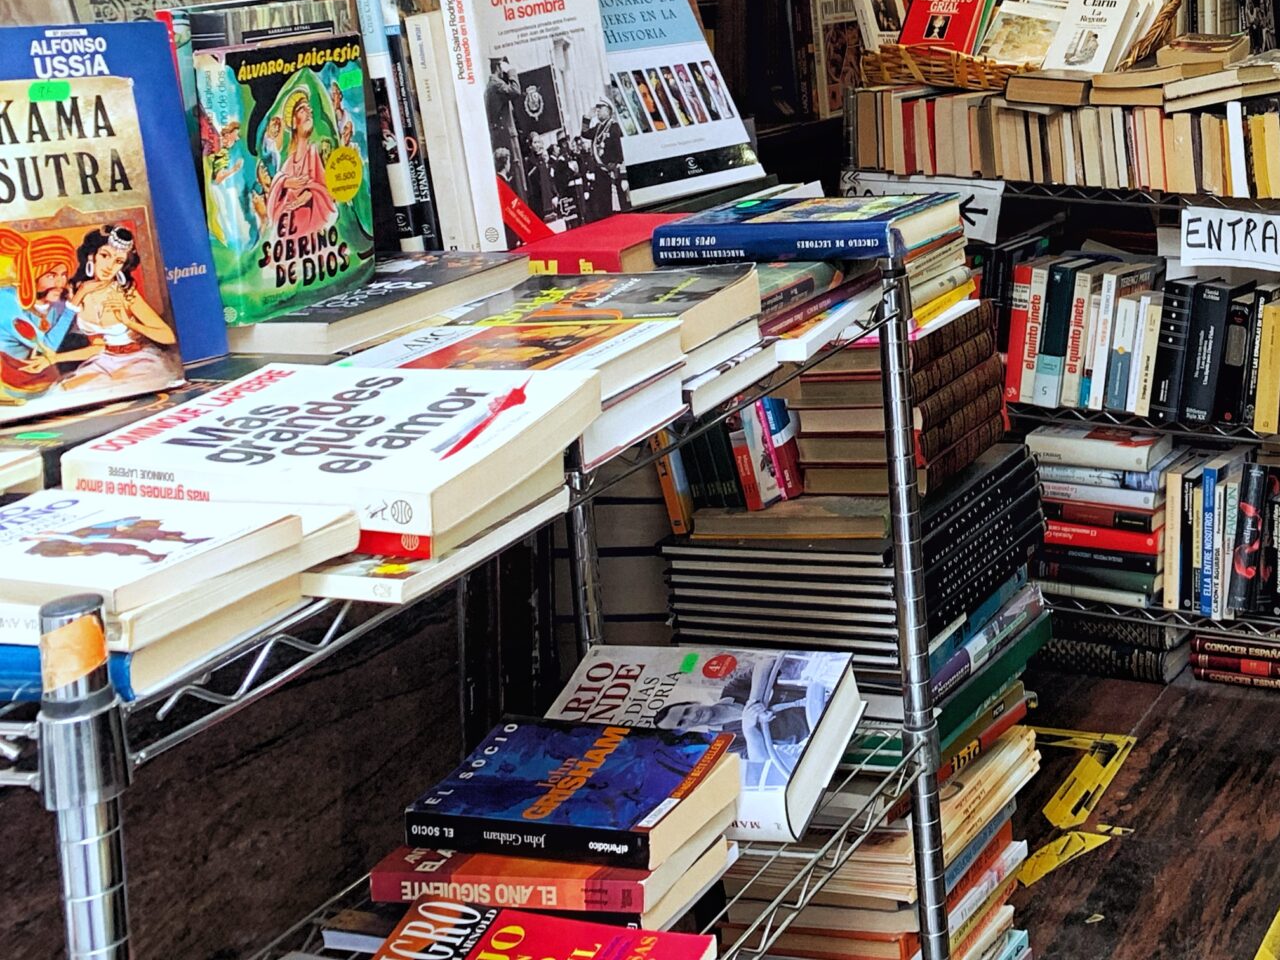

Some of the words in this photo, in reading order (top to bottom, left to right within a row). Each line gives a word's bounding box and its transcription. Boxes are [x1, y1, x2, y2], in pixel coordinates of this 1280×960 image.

[503, 5, 515, 21] la
[642, 11, 657, 21] EN
[663, 9, 677, 19] LA
[930, 2, 960, 12] GRIAL
[458, 15, 465, 23] la
[1080, 15, 1107, 23] Regenta
[460, 25, 467, 36] en
[30, 37, 107, 56] ALFONSO
[462, 37, 472, 70] reinado
[238, 59, 283, 81] ÁLVARO
[283, 62, 295, 74] DE
[456, 53, 465, 80] Pedro
[467, 72, 475, 84] Un
[0, 94, 116, 145] KAMA
[0, 148, 133, 204] SUTRA
[277, 211, 298, 238] EL
[258, 226, 338, 268] SOBRINO
[659, 236, 690, 247] NIGRUM
[694, 235, 716, 246] OPUS
[796, 240, 831, 249] LECTORES
[833, 240, 845, 248] DE
[275, 261, 297, 288] DE
[303, 242, 349, 286] DIOS
[659, 250, 698, 260] YOURCENAR
[702, 249, 745, 259] MARGUERITE
[1028, 294, 1042, 324] jinete
[1072, 298, 1084, 328] jinete
[404, 328, 457, 352] ABC
[1027, 326, 1040, 358] quinto
[1069, 329, 1082, 362] quinto
[1024, 360, 1034, 370] el
[1067, 364, 1076, 374] el
[90, 407, 202, 452] DOMINIQUE
[200, 370, 296, 415] LAPIERRE
[205, 376, 404, 466] grandes
[162, 403, 300, 449] Más
[282, 414, 386, 459] que
[318, 443, 387, 475] el
[373, 386, 490, 451] amor
[109, 466, 138, 478] LAPIERRE
[140, 470, 174, 482] DOMINIQUE
[76, 478, 103, 493] amor
[105, 479, 115, 494] el
[117, 479, 136, 497] que
[930, 491, 975, 527] PINTURA
[949, 497, 992, 534] PINTURA
[1205, 512, 1213, 551] NOSOTROS
[1244, 518, 1256, 543] eclipse
[943, 522, 1004, 571] ARQUITECTURA
[939, 536, 998, 586] ARQUITECTURA
[942, 545, 1002, 597] ARQUITECTURA
[1204, 553, 1212, 575] ENTRE
[1204, 580, 1212, 596] ELLA
[1204, 642, 1247, 655] CONOCER
[1209, 673, 1251, 686] CONOCER
[625, 677, 660, 717] DÍAS
[425, 789, 453, 806] EL
[459, 722, 518, 780] SOCIO
[522, 726, 631, 820] GRISHAM
[536, 756, 578, 790] John
[411, 825, 438, 836] SOCIO
[441, 826, 454, 837] EL
[483, 830, 522, 846] Grisham
[523, 833, 547, 848] John
[400, 881, 491, 904] SIGUIENTE
[495, 884, 534, 908] AÑO
[537, 885, 557, 905] EL
[459, 908, 498, 958] ARNOLD
